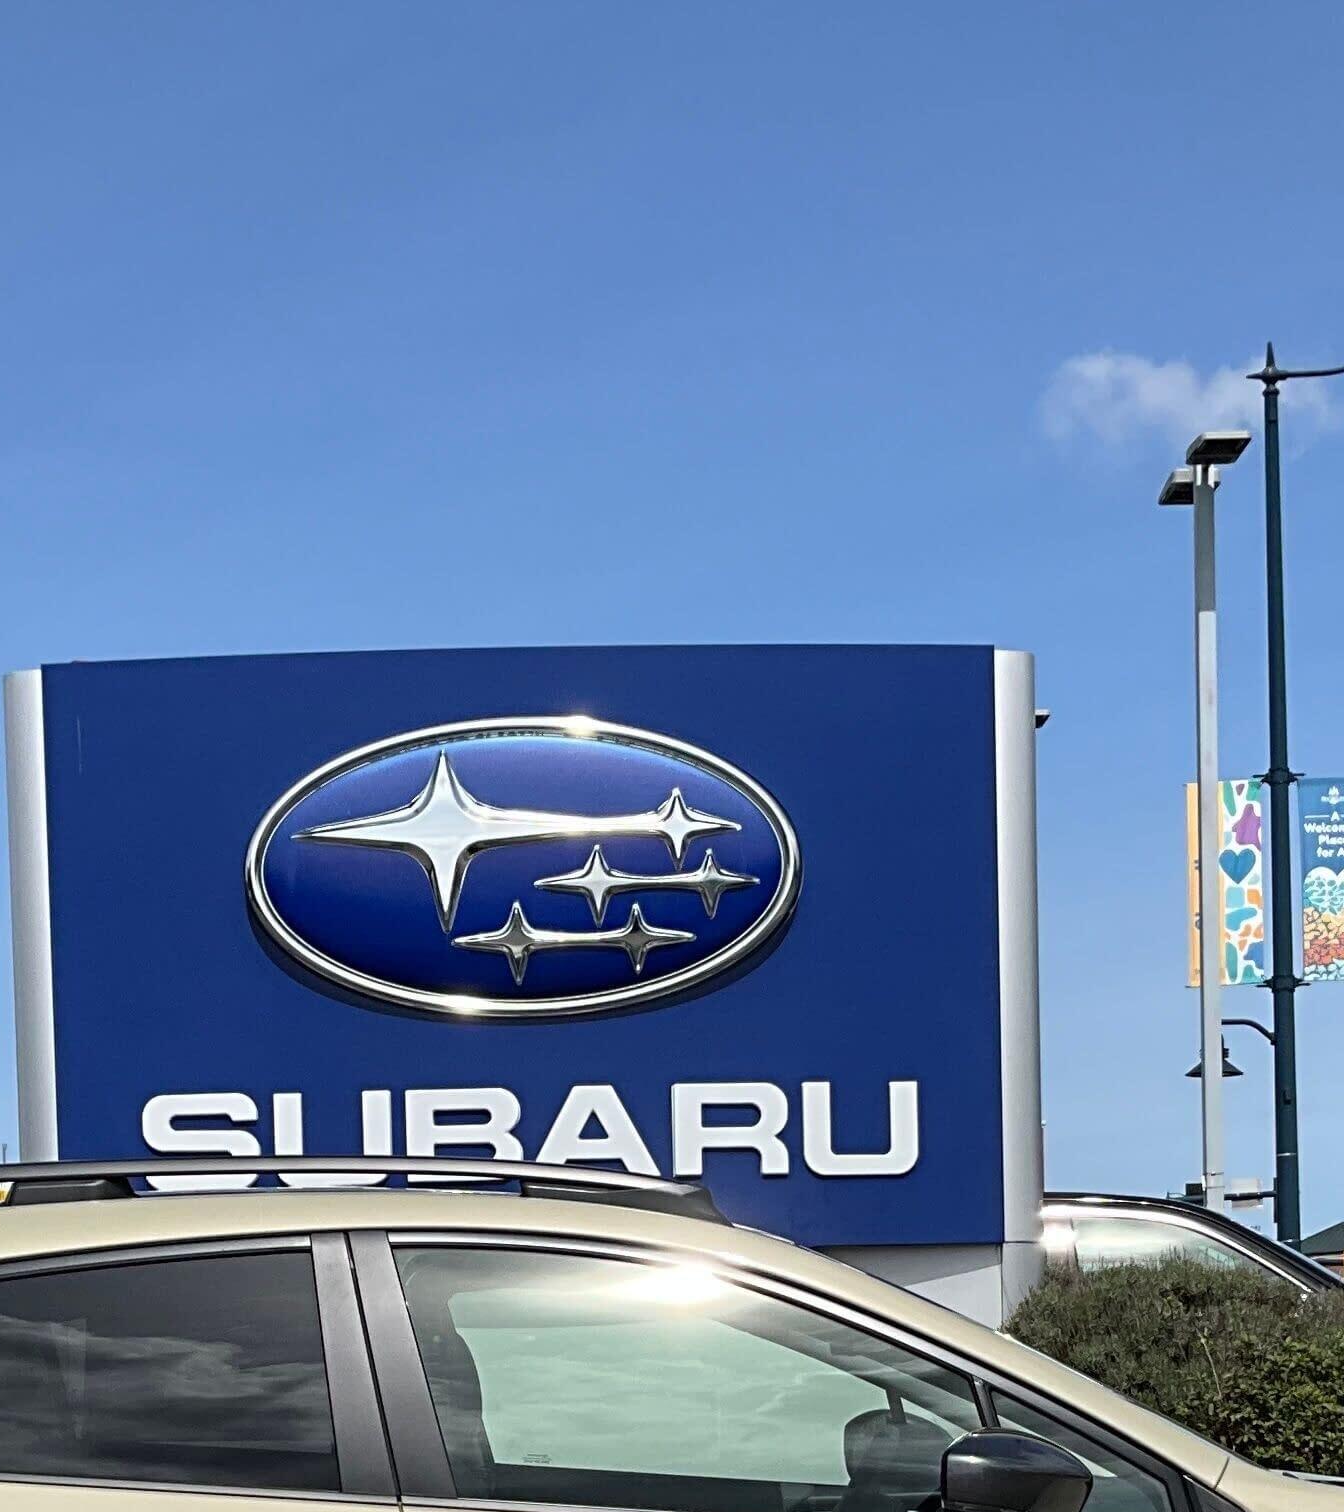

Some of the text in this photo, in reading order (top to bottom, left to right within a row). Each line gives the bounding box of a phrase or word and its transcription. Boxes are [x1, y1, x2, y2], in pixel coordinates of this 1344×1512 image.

[1330, 811, 1340, 821] A
[1316, 847, 1334, 858] for
[141, 1080, 919, 1192] SUBARU
